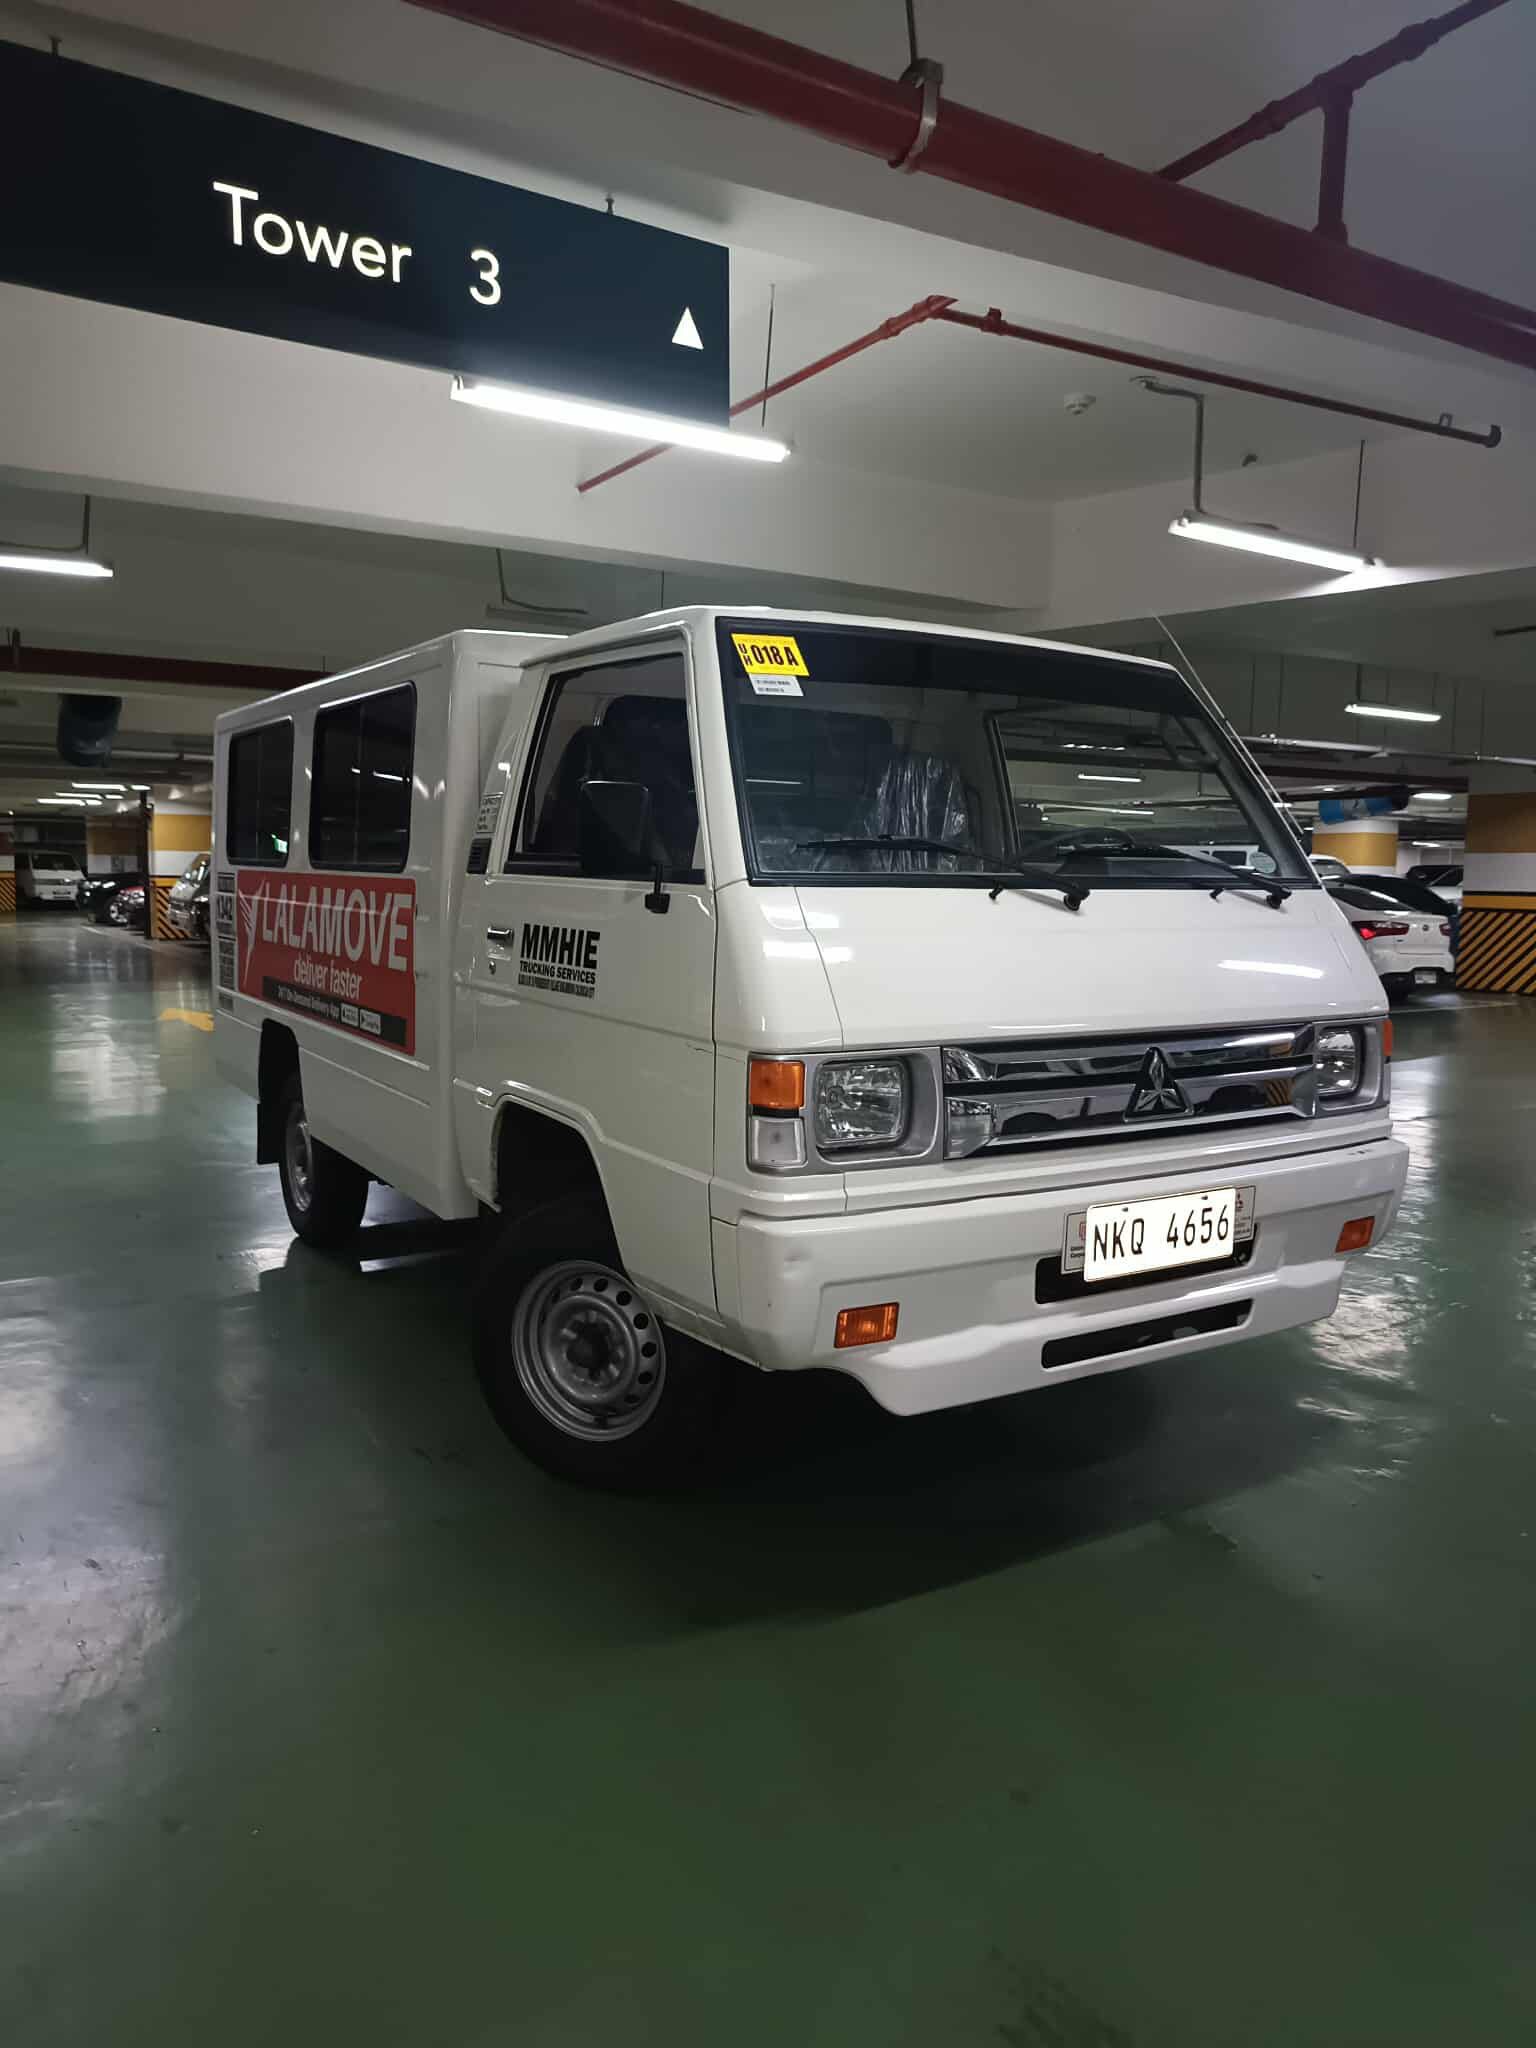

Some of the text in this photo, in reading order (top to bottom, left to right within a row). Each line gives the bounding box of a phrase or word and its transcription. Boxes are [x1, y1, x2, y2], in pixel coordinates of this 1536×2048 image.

[212, 180, 502, 306] Tower 3
[262, 882, 413, 972] LALAMOVE
[520, 923, 601, 970] MMHIE
[293, 952, 362, 1000] deliver faster
[519, 960, 596, 985] TRUCKING SERVICES
[1093, 1217, 1146, 1262] NKQ
[1166, 1204, 1230, 1249] 4656
